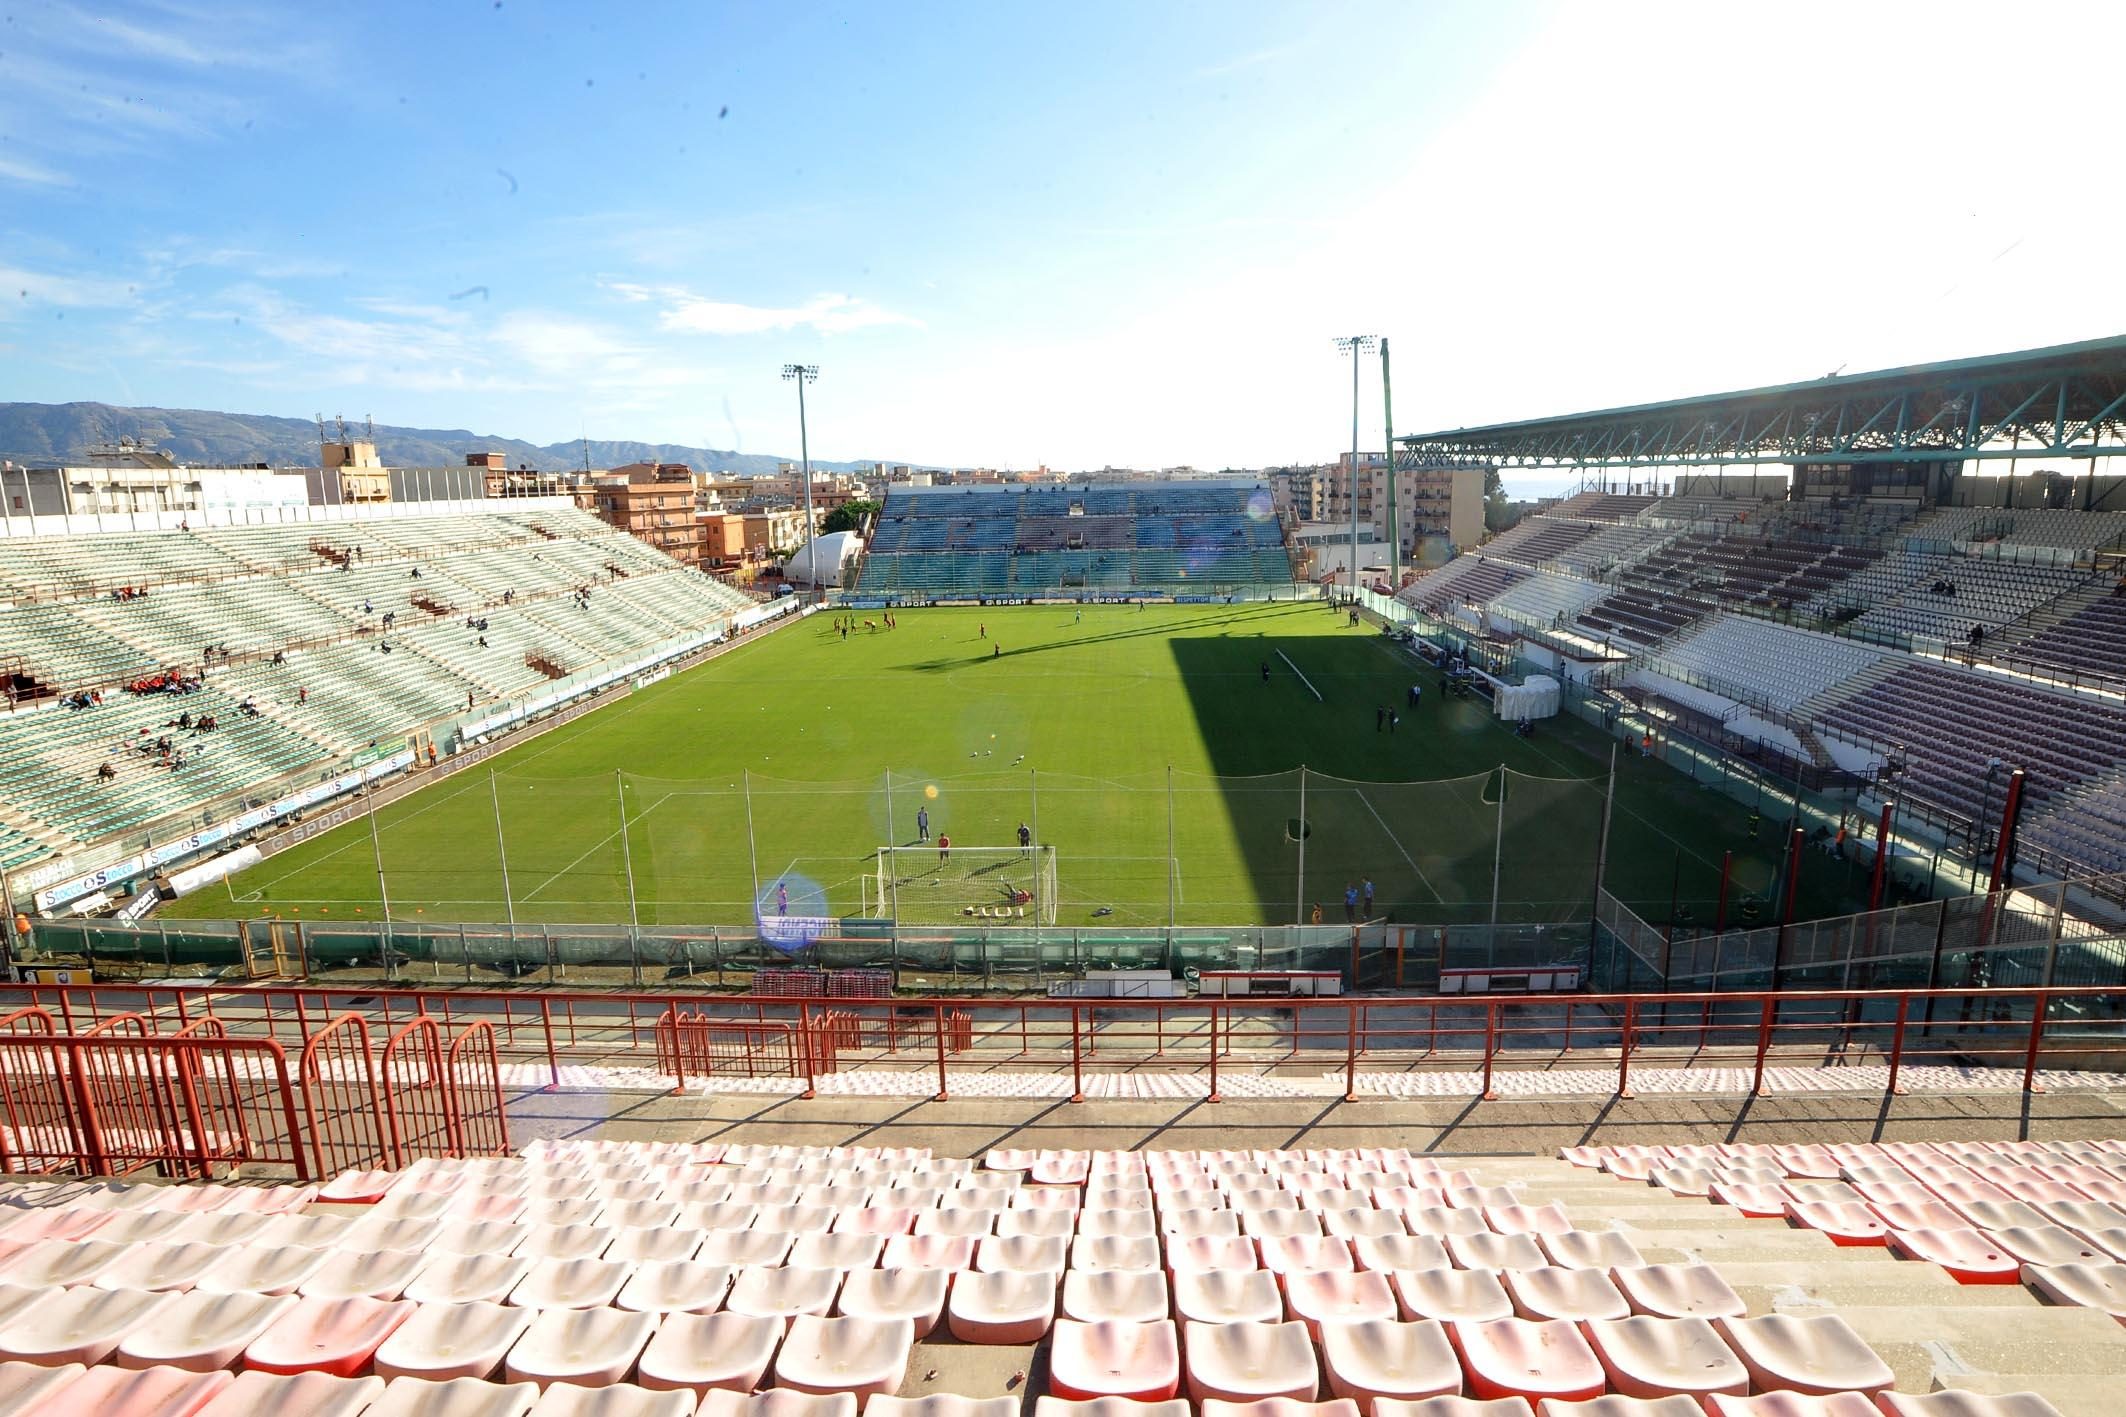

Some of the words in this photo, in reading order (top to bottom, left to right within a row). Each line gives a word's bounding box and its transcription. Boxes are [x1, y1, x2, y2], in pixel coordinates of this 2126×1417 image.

[441, 764, 450, 775] G
[455, 746, 495, 768] SPORT
[272, 838, 283, 851] G
[292, 806, 354, 841] SPORT
[45, 882, 82, 905] Stocco
[96, 863, 133, 886] Stocco
[128, 888, 156, 915] SPORT
